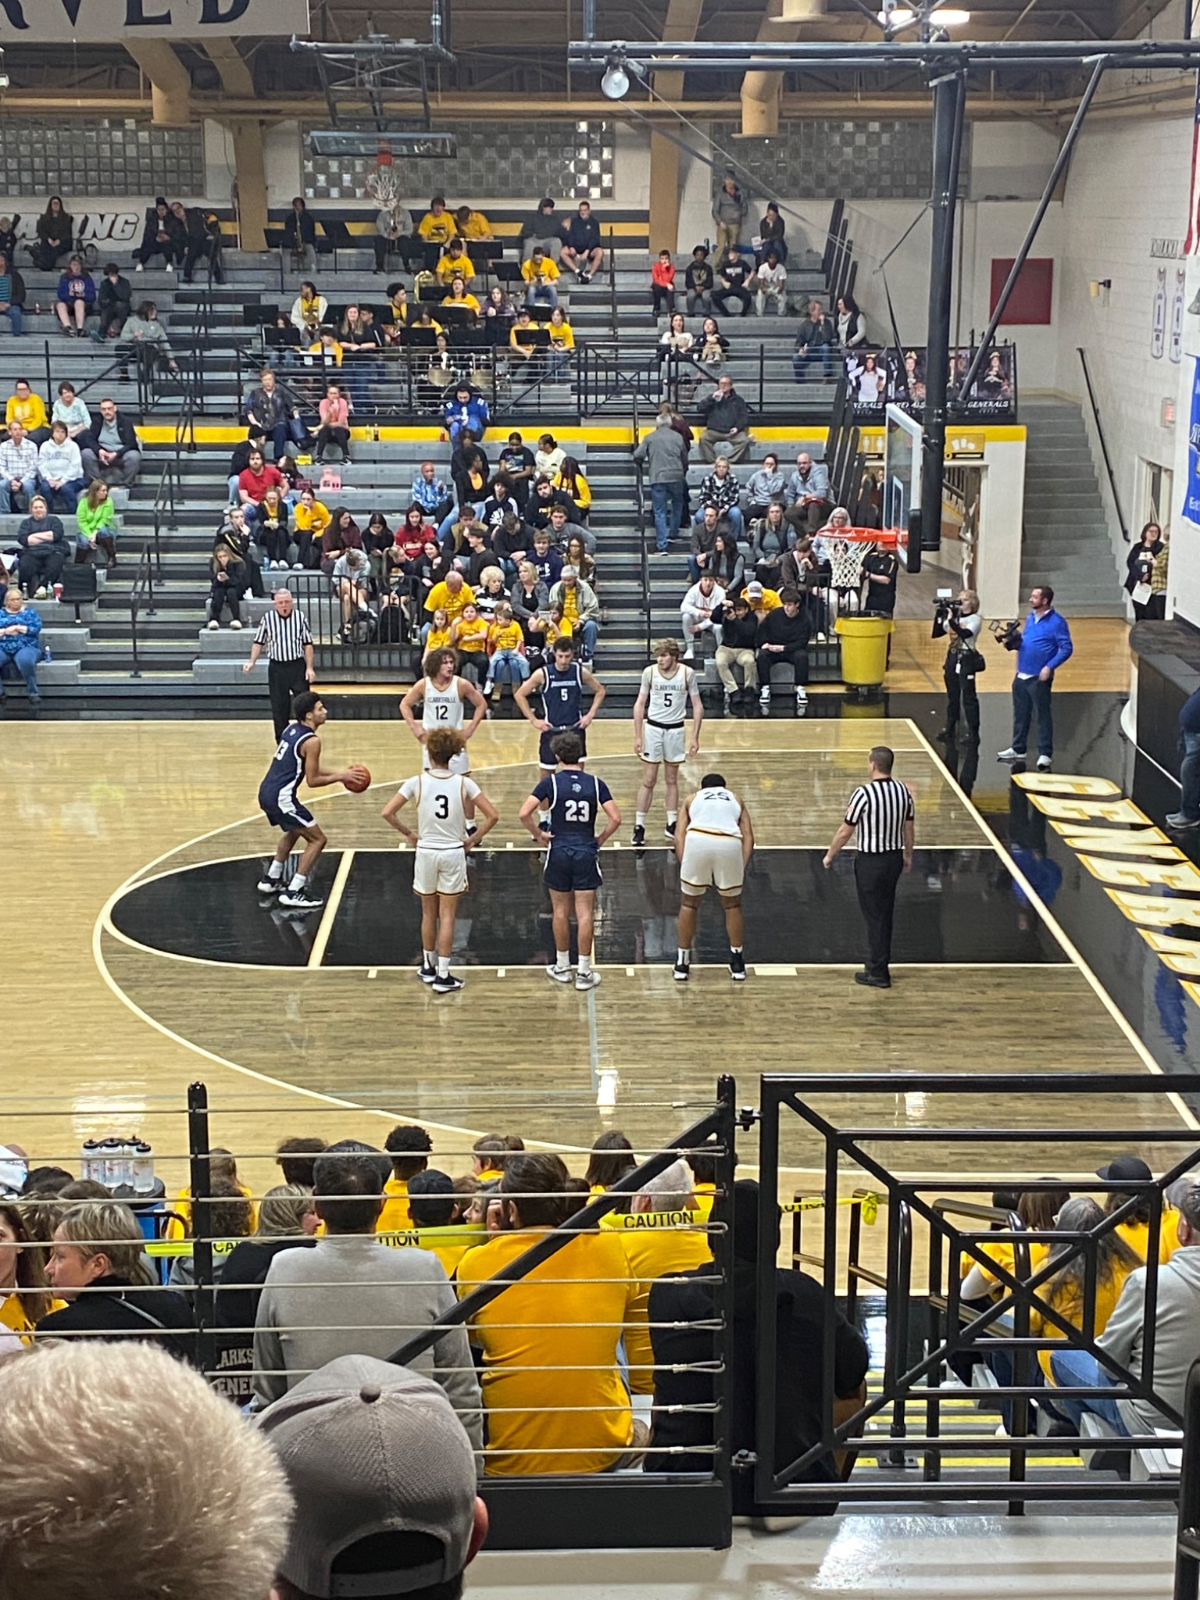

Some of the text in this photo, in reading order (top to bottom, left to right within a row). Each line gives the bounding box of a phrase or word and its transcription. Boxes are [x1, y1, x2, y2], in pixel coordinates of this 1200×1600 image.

[561, 688, 569, 702] 5
[663, 693, 673, 707] 5
[435, 705, 448, 720] 12
[435, 794, 449, 819] 3
[565, 800, 590, 822] 23
[623, 1210, 694, 1228] CAUTION
